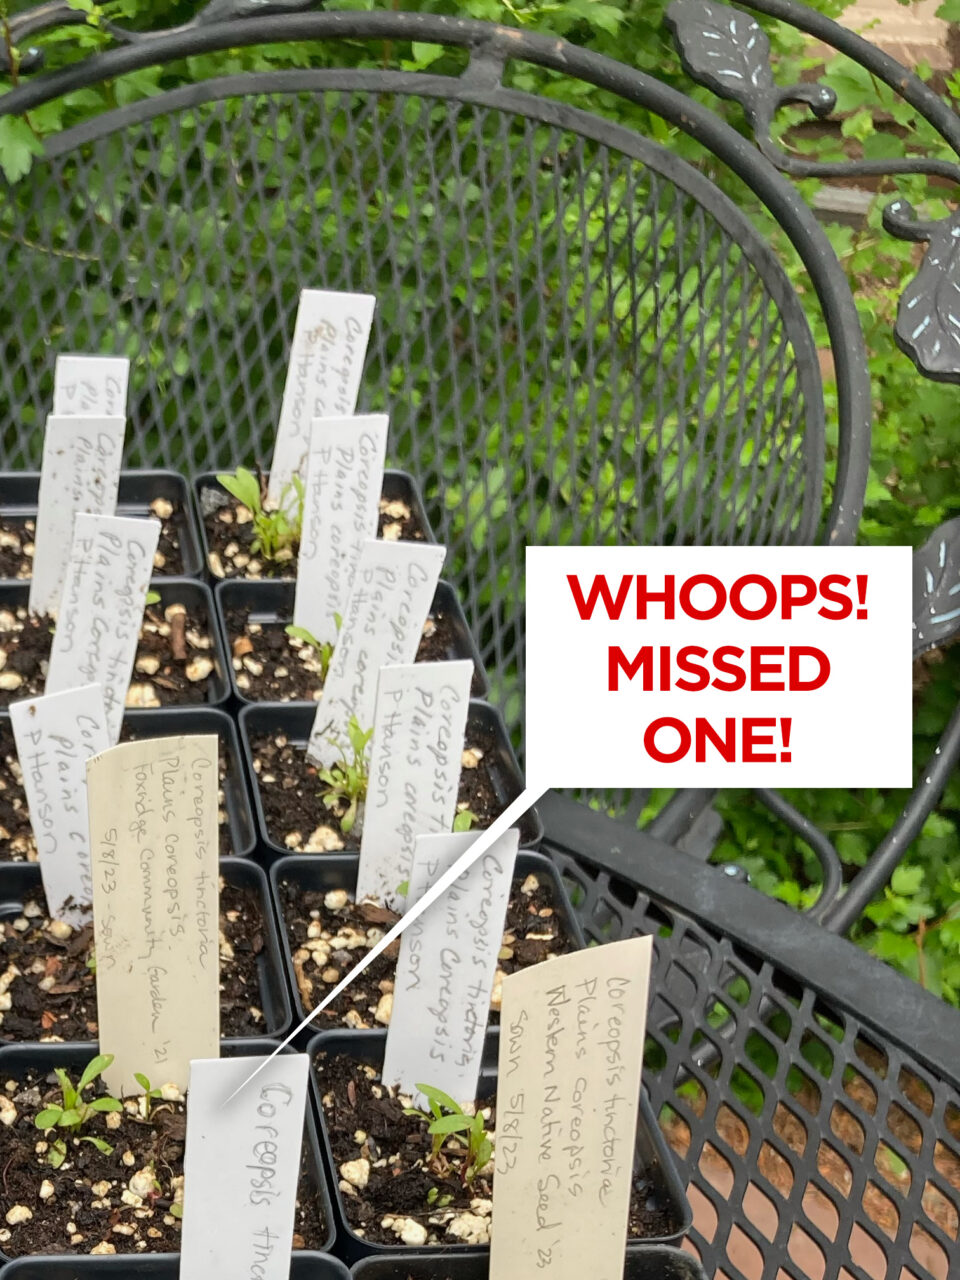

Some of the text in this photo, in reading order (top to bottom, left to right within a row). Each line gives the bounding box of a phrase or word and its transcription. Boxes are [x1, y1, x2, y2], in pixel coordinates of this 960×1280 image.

[91, 530, 122, 609] Plains
[114, 539, 146, 639] Coreopsis
[363, 565, 396, 635] Plains
[375, 710, 402, 808] Hanson
[406, 686, 434, 766] Plains
[426, 684, 460, 805] Coreopsis
[26, 750, 57, 856] Hanson
[47, 733, 78, 813] Plains
[128, 762, 155, 844] Foxridge
[160, 754, 180, 823] Plains
[98, 827, 120, 895] 5/8/23
[184, 756, 214, 969] Coreopsis tinctoria
[468, 853, 504, 968] Coreopsis
[542, 983, 568, 1078] Western
[574, 976, 599, 1060] Plains
[495, 1008, 529, 1175] Sown 5/8/23
[537, 1084, 563, 1161] Native
[596, 975, 632, 1206] Coreopsis tinctoria
[244, 1086, 294, 1206] Coreopsis
[534, 1173, 563, 1232] Seed
